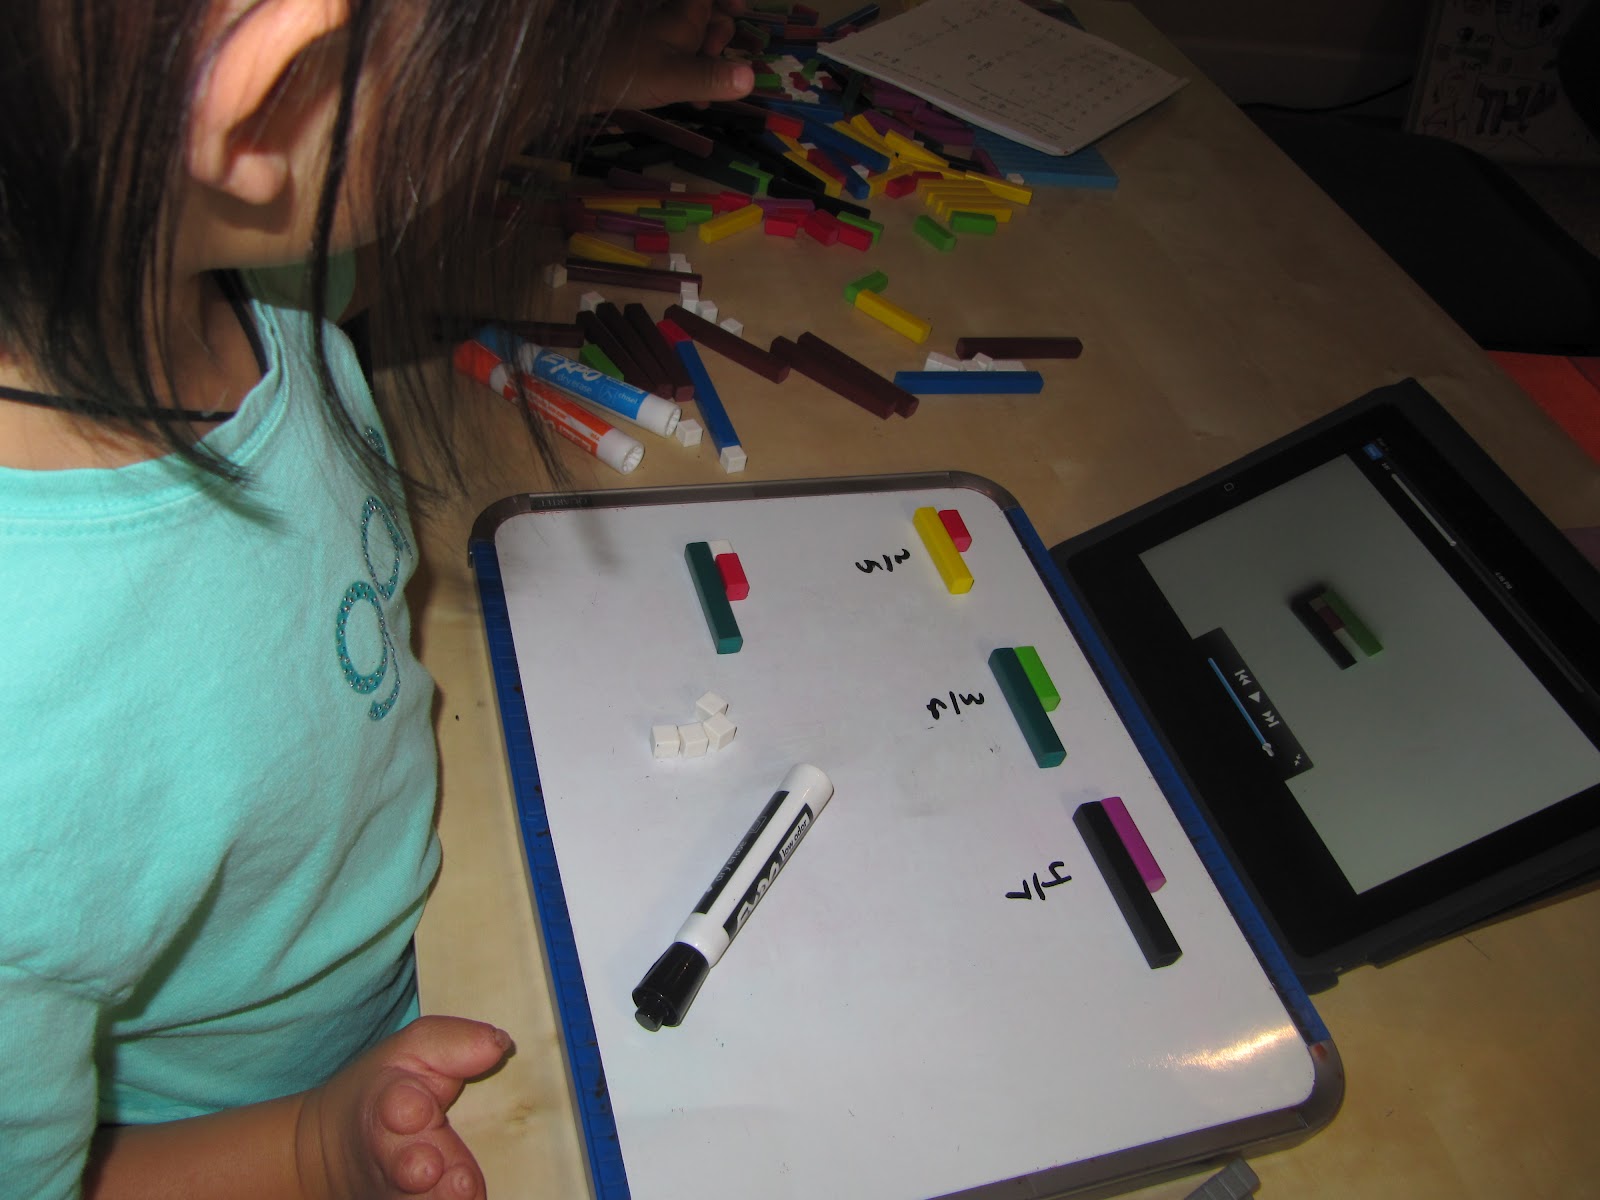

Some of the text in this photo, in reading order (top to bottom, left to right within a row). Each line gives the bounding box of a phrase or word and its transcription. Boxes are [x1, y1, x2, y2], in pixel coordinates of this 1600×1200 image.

[541, 353, 601, 381] EXPO
[557, 372, 571, 386] dry
[572, 379, 593, 393] erase
[618, 391, 638, 404] chisel
[782, 819, 807, 857] low odor
